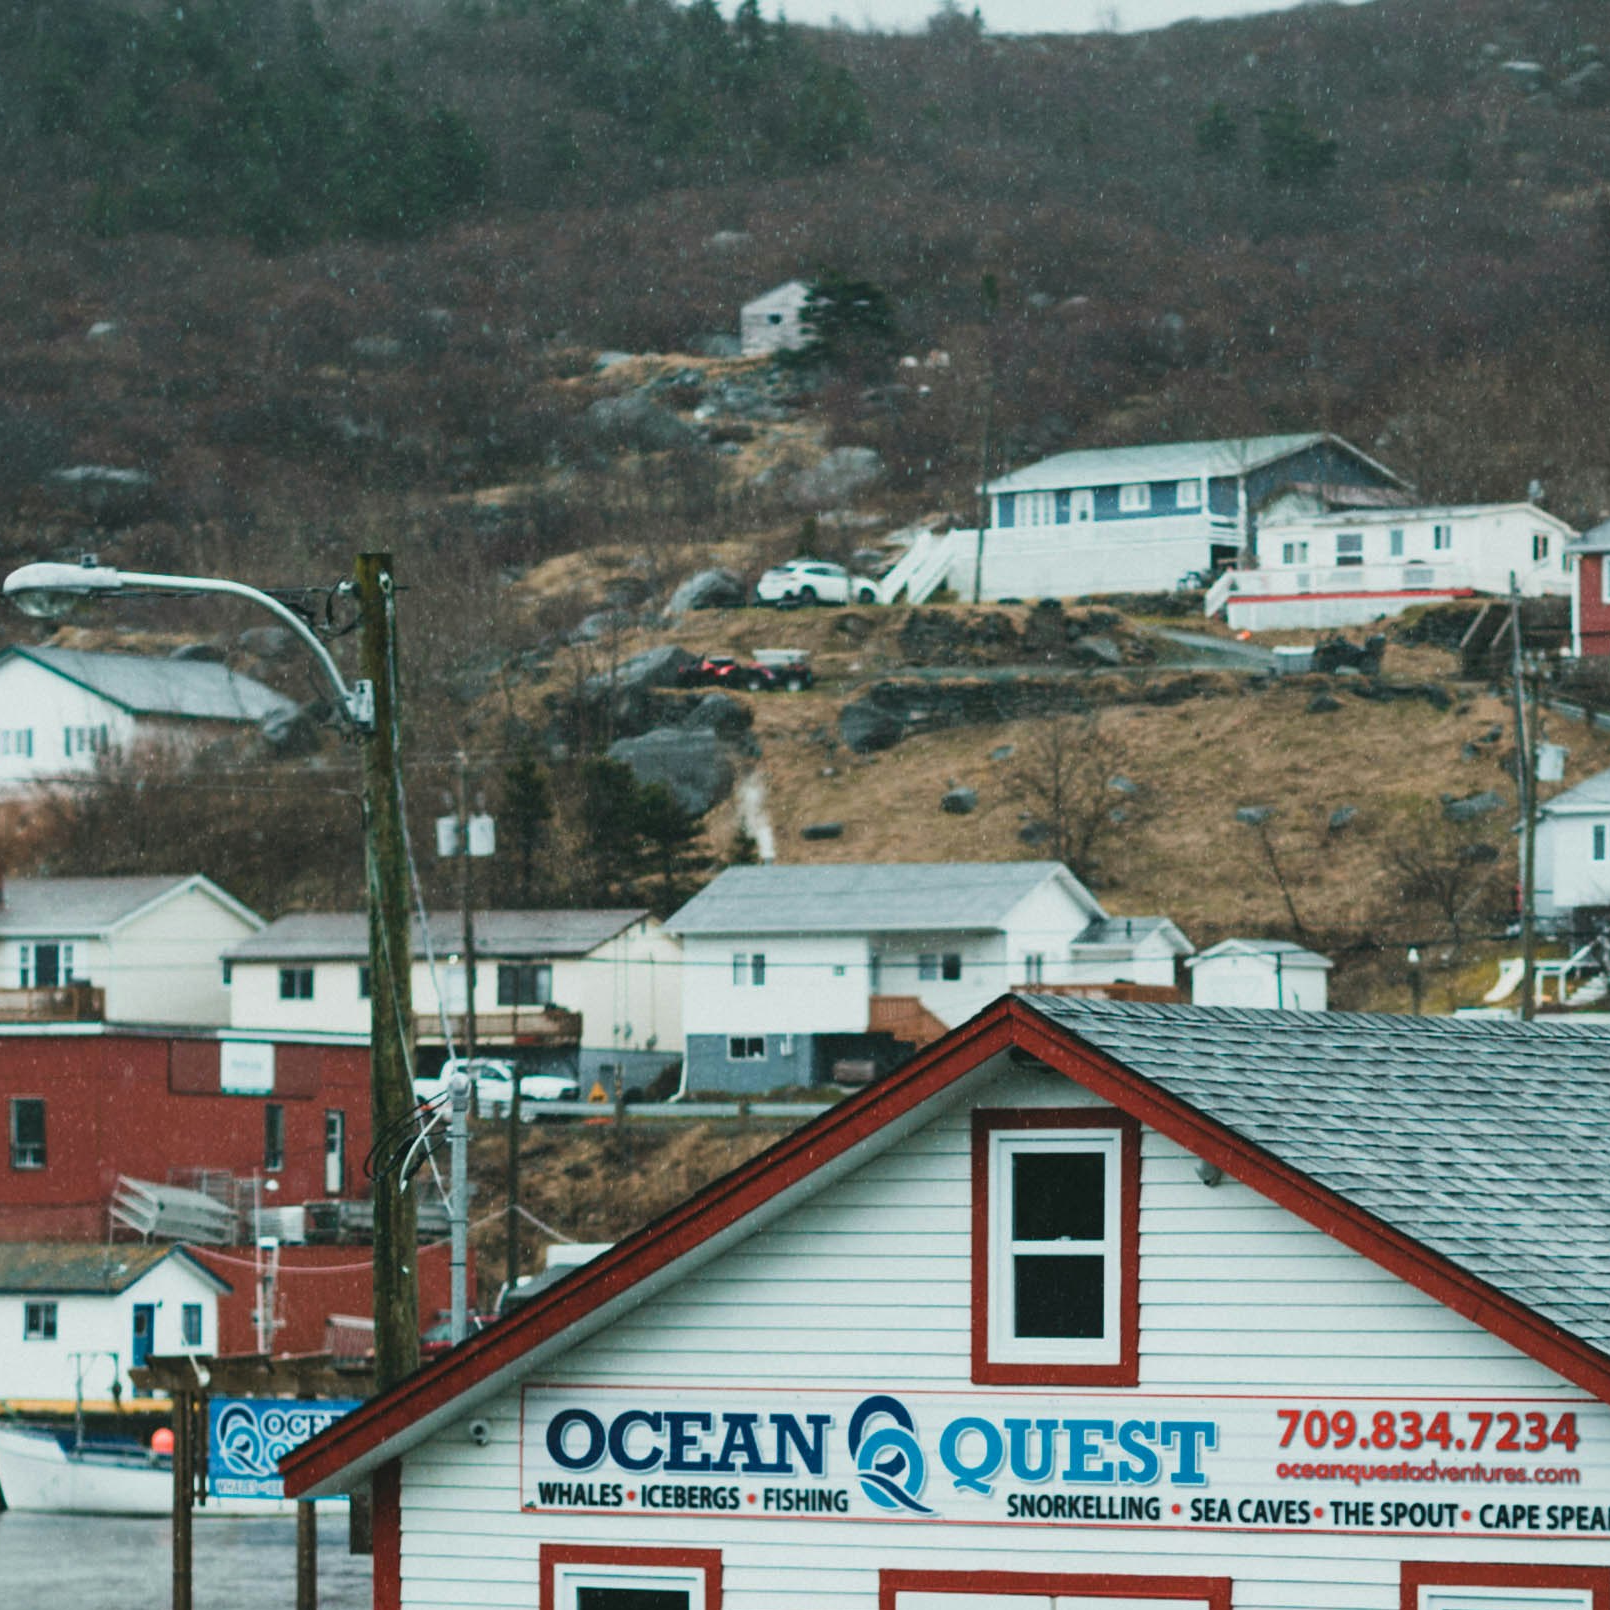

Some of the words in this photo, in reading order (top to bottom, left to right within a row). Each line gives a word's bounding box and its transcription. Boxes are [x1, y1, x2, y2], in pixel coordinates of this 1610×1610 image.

[545, 1408, 832, 1475] OCEAN
[938, 1416, 1217, 1494] QUEST
[1276, 1409, 1580, 1452] 709.834.7234
[1275, 1459, 1581, 1486] oceanquestadventures.com
[538, 1482, 623, 1507] WHALES
[640, 1484, 740, 1510] ICEBERGS
[762, 1487, 849, 1512] FISHING
[1007, 1493, 1161, 1520] SNORKELLING
[1190, 1498, 1232, 1523] SEA
[1237, 1499, 1311, 1525] CAVES
[1330, 1501, 1374, 1526] THE
[1380, 1502, 1459, 1528] SPOUT
[1479, 1503, 1540, 1530] CAPE
